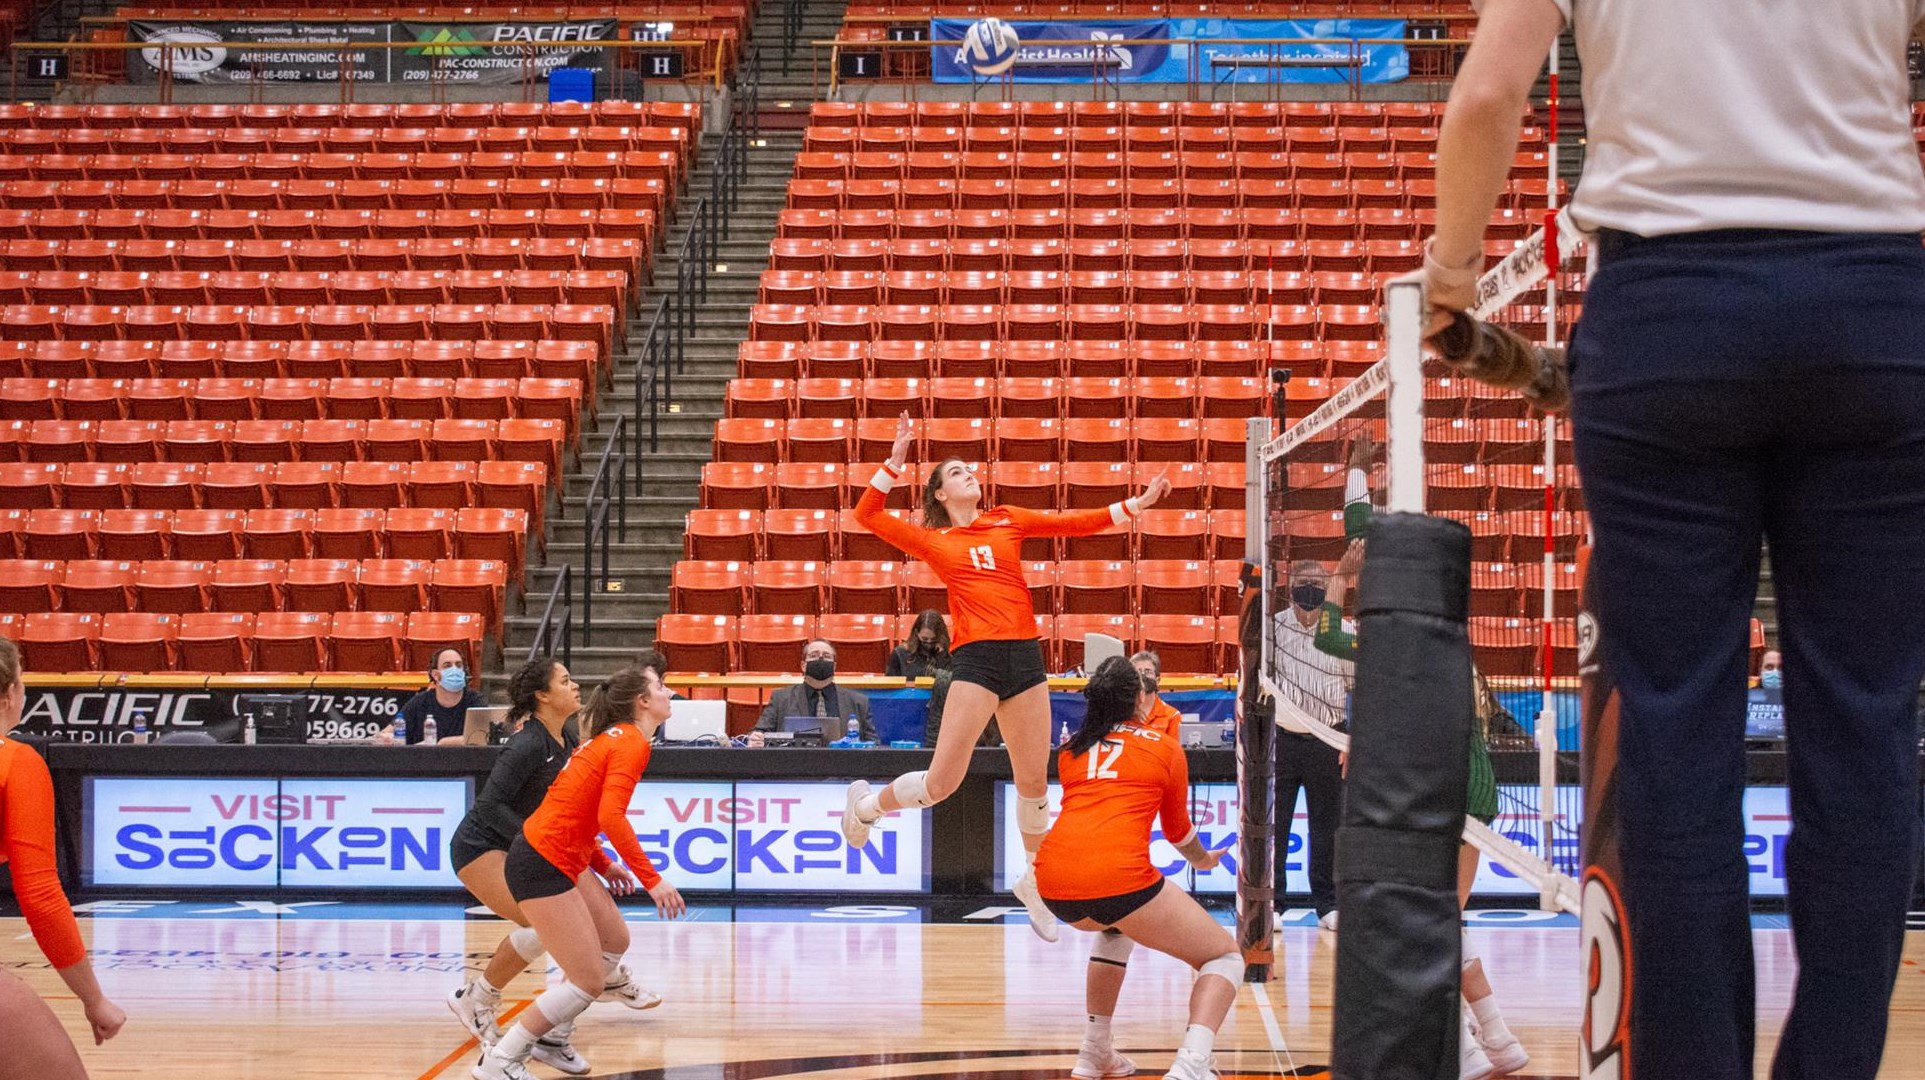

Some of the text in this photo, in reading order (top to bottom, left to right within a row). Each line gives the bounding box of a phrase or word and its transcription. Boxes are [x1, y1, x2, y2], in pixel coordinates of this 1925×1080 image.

[492, 24, 605, 42] PACIFIC
[40, 59, 57, 77] H
[653, 57, 671, 75] H
[968, 544, 997, 572] 13
[20, 693, 212, 726] ACIFIC
[307, 694, 399, 716] 77-2766
[1087, 739, 1125, 780] 12
[210, 794, 346, 821] VISIT
[664, 797, 802, 824] VISIT
